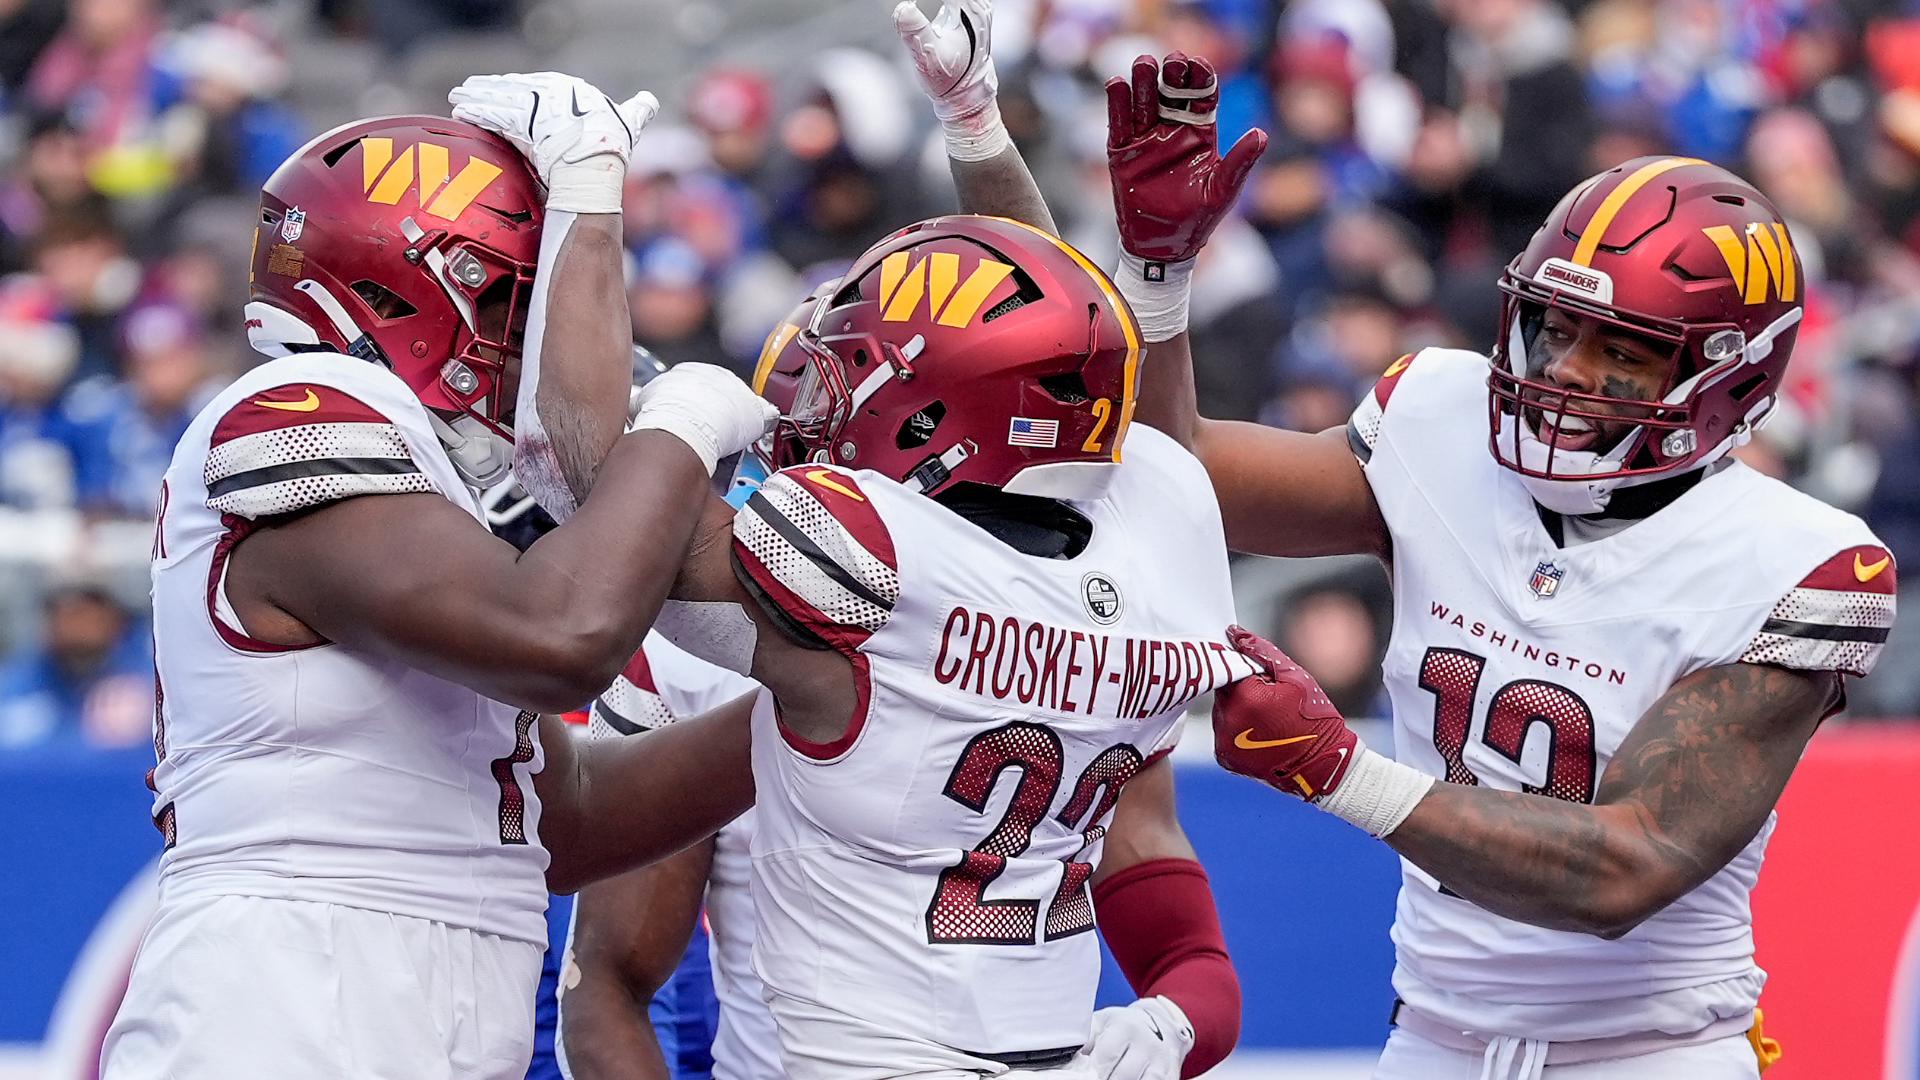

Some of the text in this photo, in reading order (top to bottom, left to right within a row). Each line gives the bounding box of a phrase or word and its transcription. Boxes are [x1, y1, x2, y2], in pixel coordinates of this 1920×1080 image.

[1082, 398, 1111, 452] 2
[1430, 601, 1625, 685] WASHINGTON
[925, 720, 1143, 945] 22
